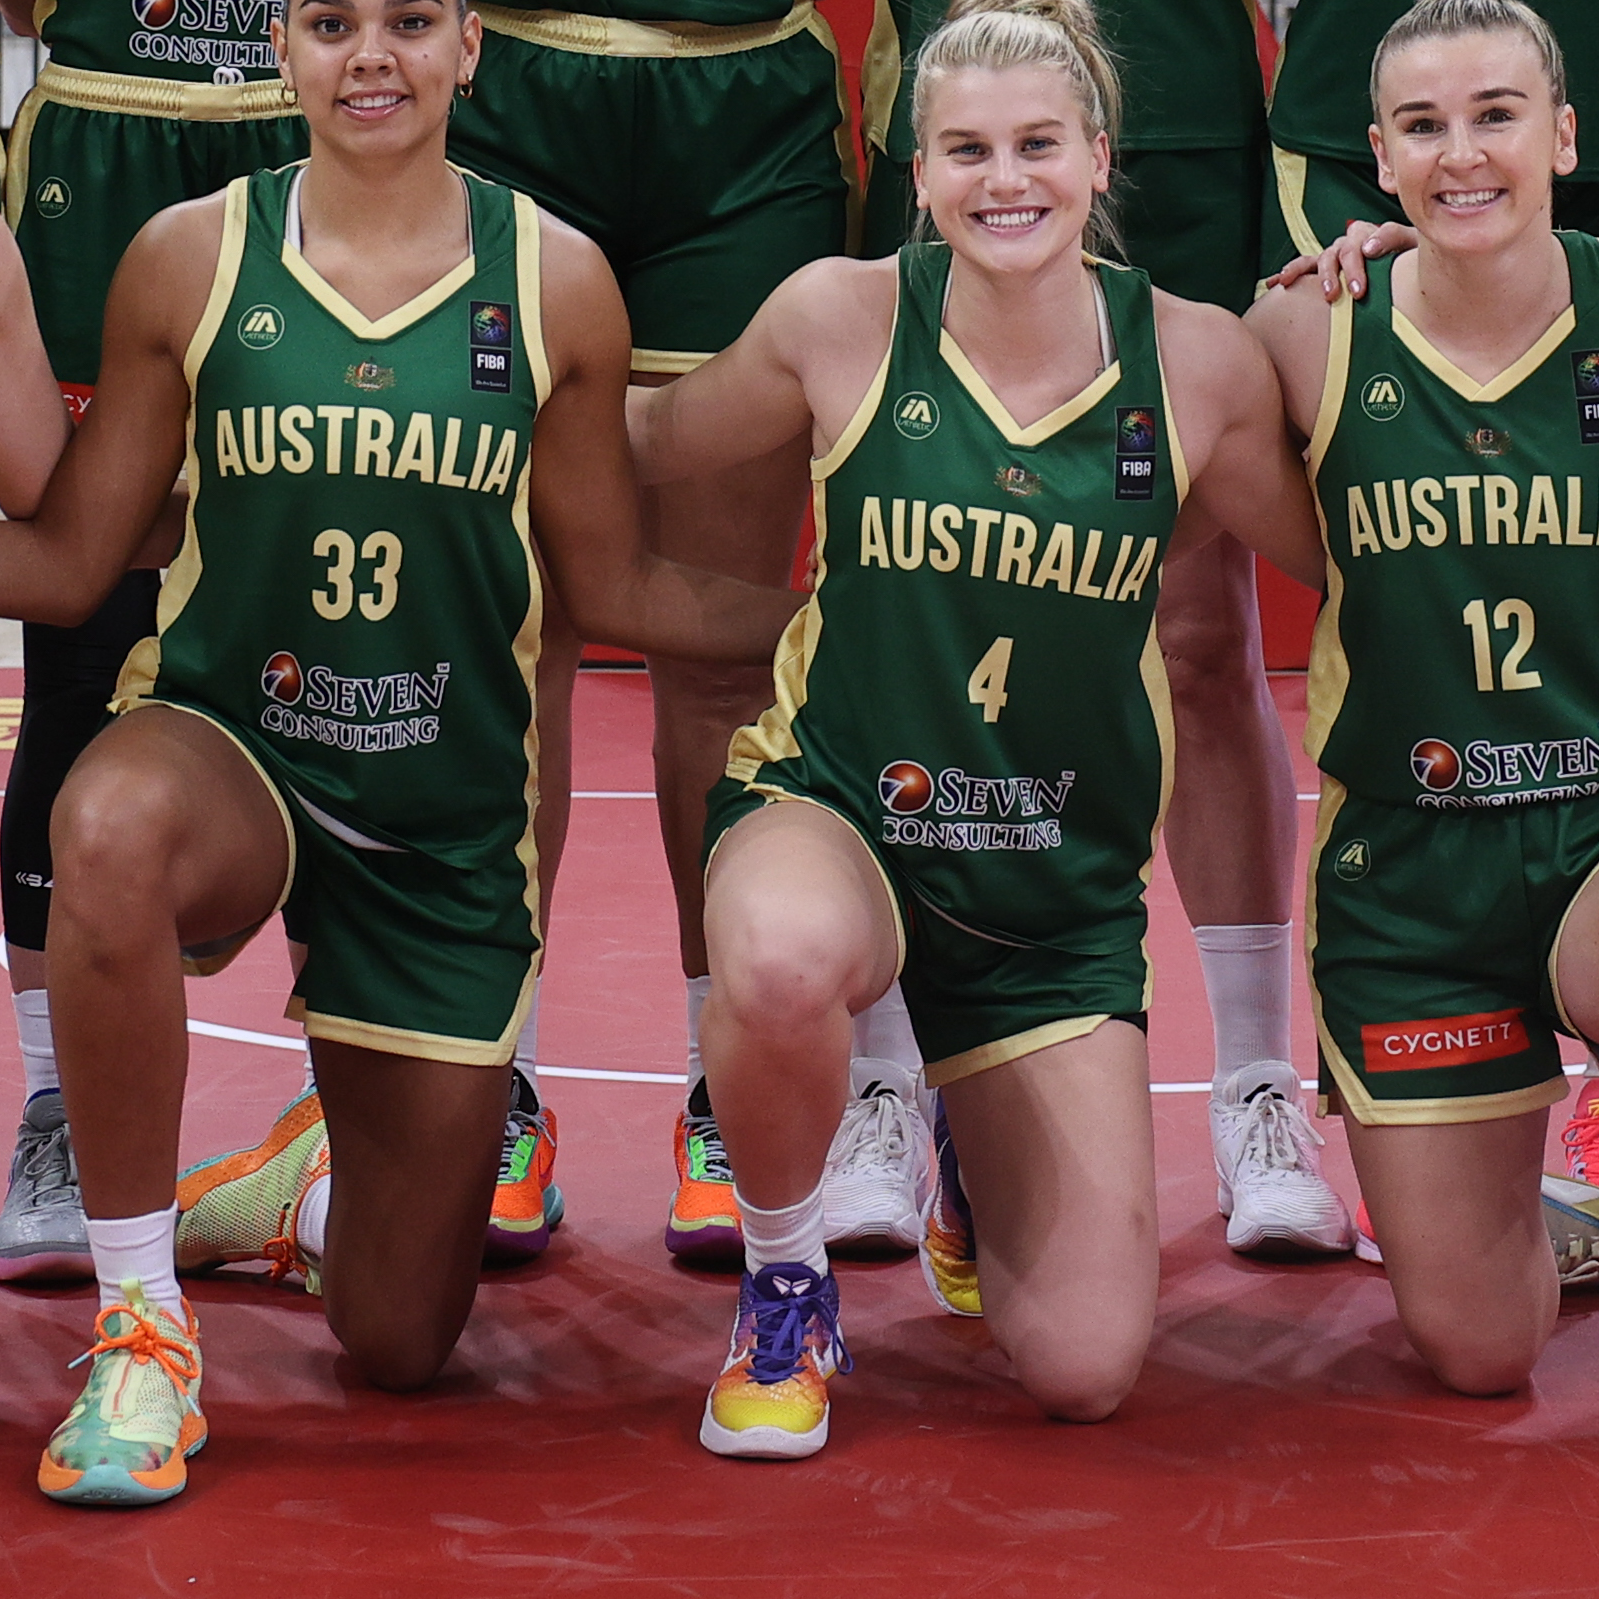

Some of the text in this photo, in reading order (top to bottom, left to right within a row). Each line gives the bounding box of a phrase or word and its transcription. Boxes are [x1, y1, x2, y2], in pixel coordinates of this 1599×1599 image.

[129, 31, 278, 68] CONSULTI
[476, 353, 506, 371] FIBA
[216, 405, 519, 497] AUSTRALIA
[1122, 461, 1151, 477] FIBA
[312, 528, 403, 621] 33
[859, 495, 1160, 603] AUSTRALIA
[1462, 597, 1543, 692] 12
[307, 664, 448, 720] SEVEN
[967, 636, 1014, 723] 4
[260, 701, 440, 753] CONSULTING
[936, 769, 1072, 817] SEVEN
[881, 815, 1062, 852] CONSULTING
[1383, 1021, 1512, 1056] CYGNETT
